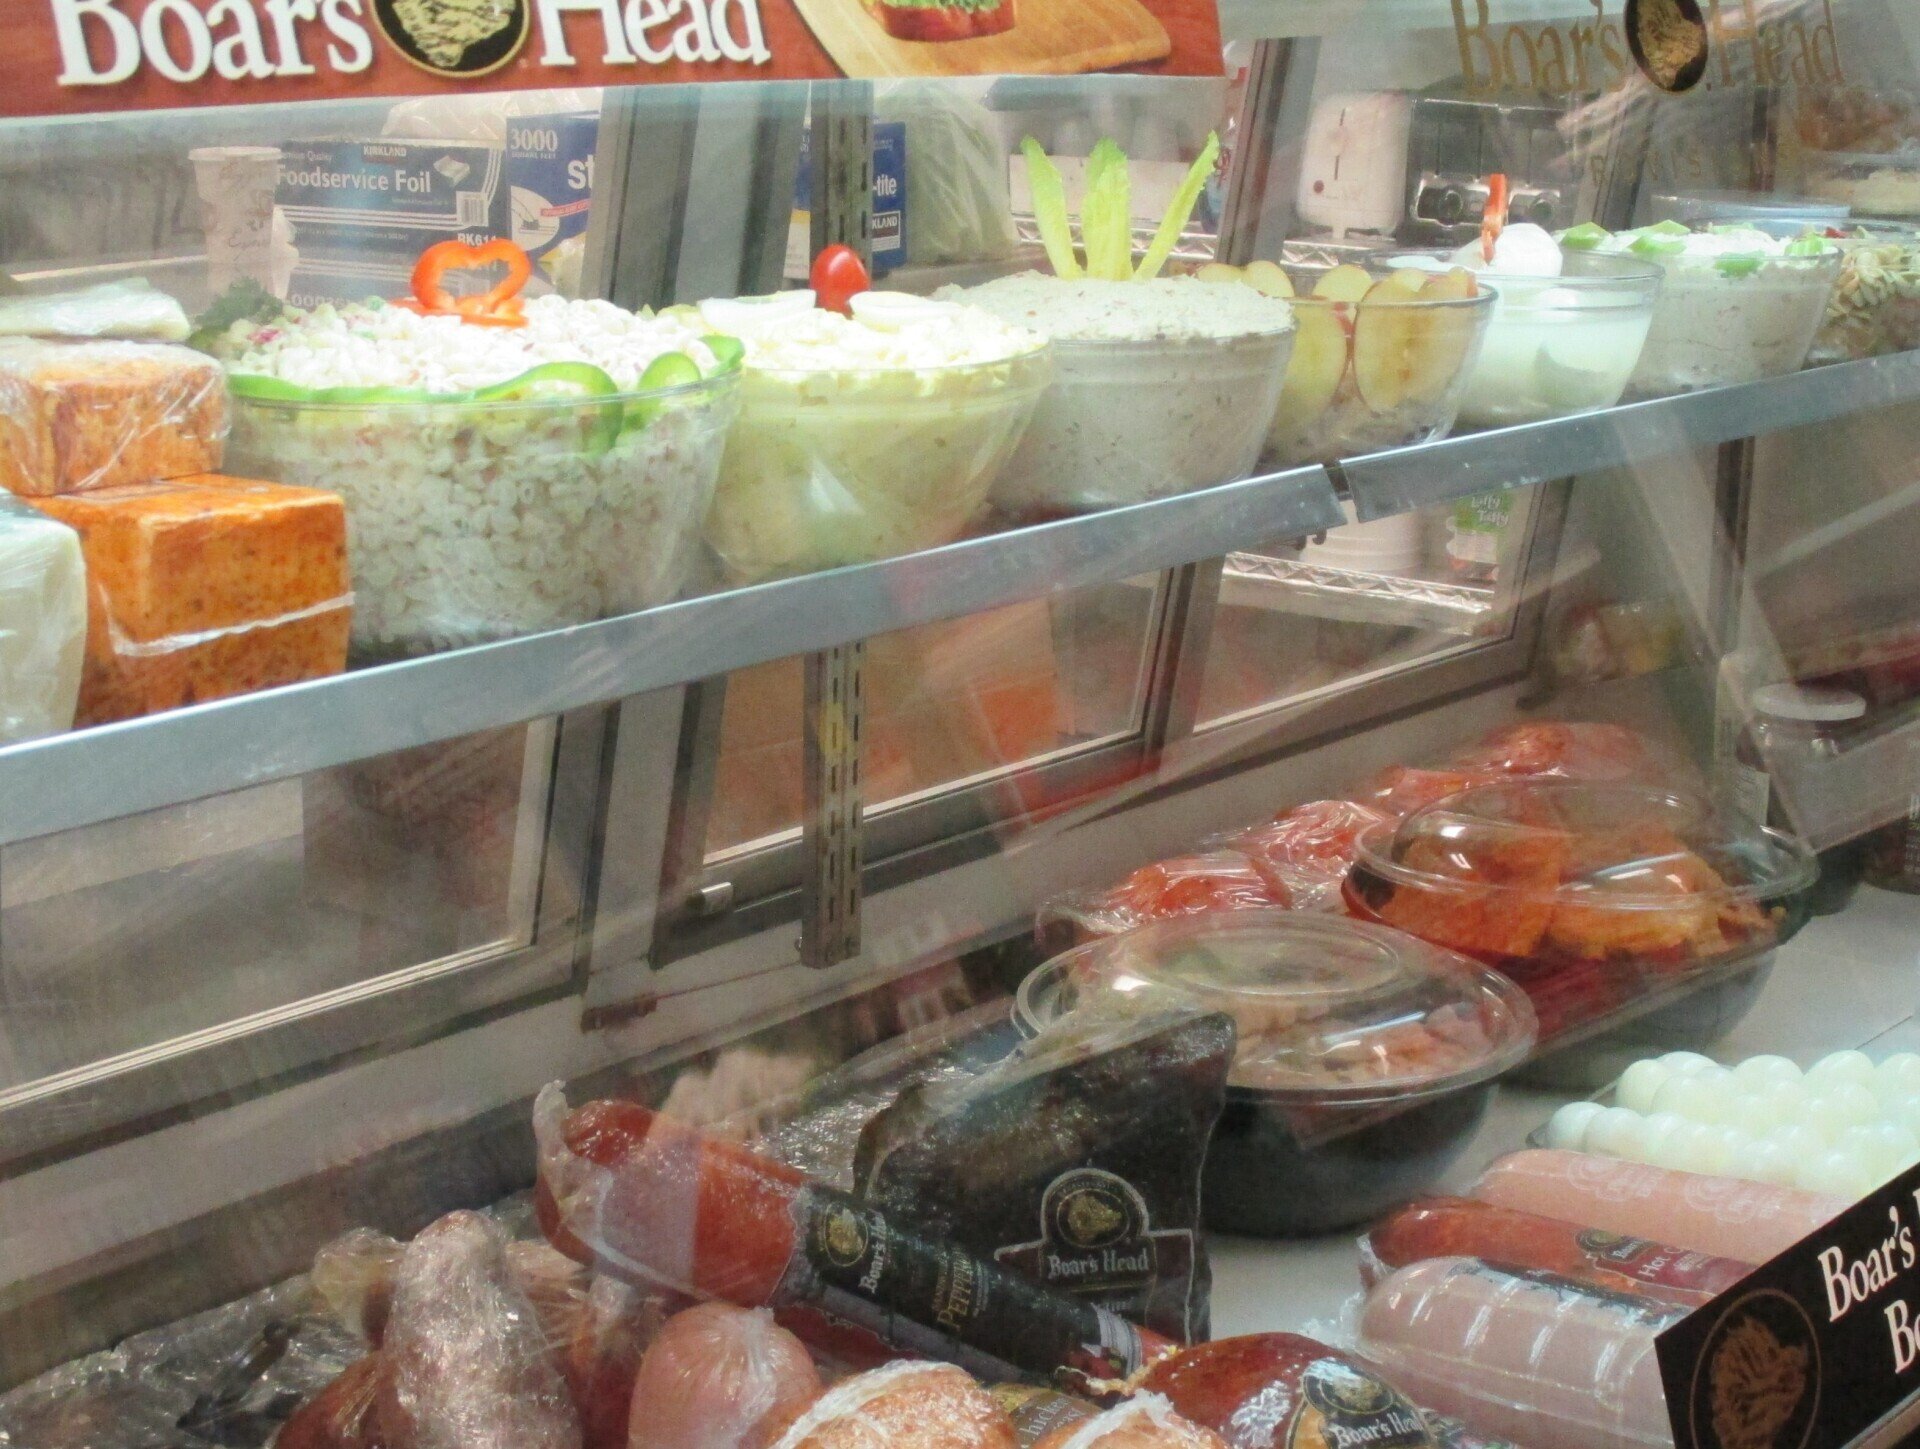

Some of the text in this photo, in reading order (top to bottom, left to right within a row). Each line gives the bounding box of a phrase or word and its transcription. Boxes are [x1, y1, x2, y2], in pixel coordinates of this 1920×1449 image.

[52, 0, 772, 86] Boars Head
[1708, 0, 1846, 88] Head
[363, 145, 408, 158] KIRKLAND
[510, 127, 559, 152] 3000
[276, 163, 431, 193] Foodservice Foil
[1047, 1248, 1149, 1280] Boar's Head
[1637, 1254, 1672, 1278] Hot
[1817, 1205, 1916, 1323] Boar's
[1883, 1298, 1920, 1374] B
[1328, 1416, 1393, 1448] Boar's
